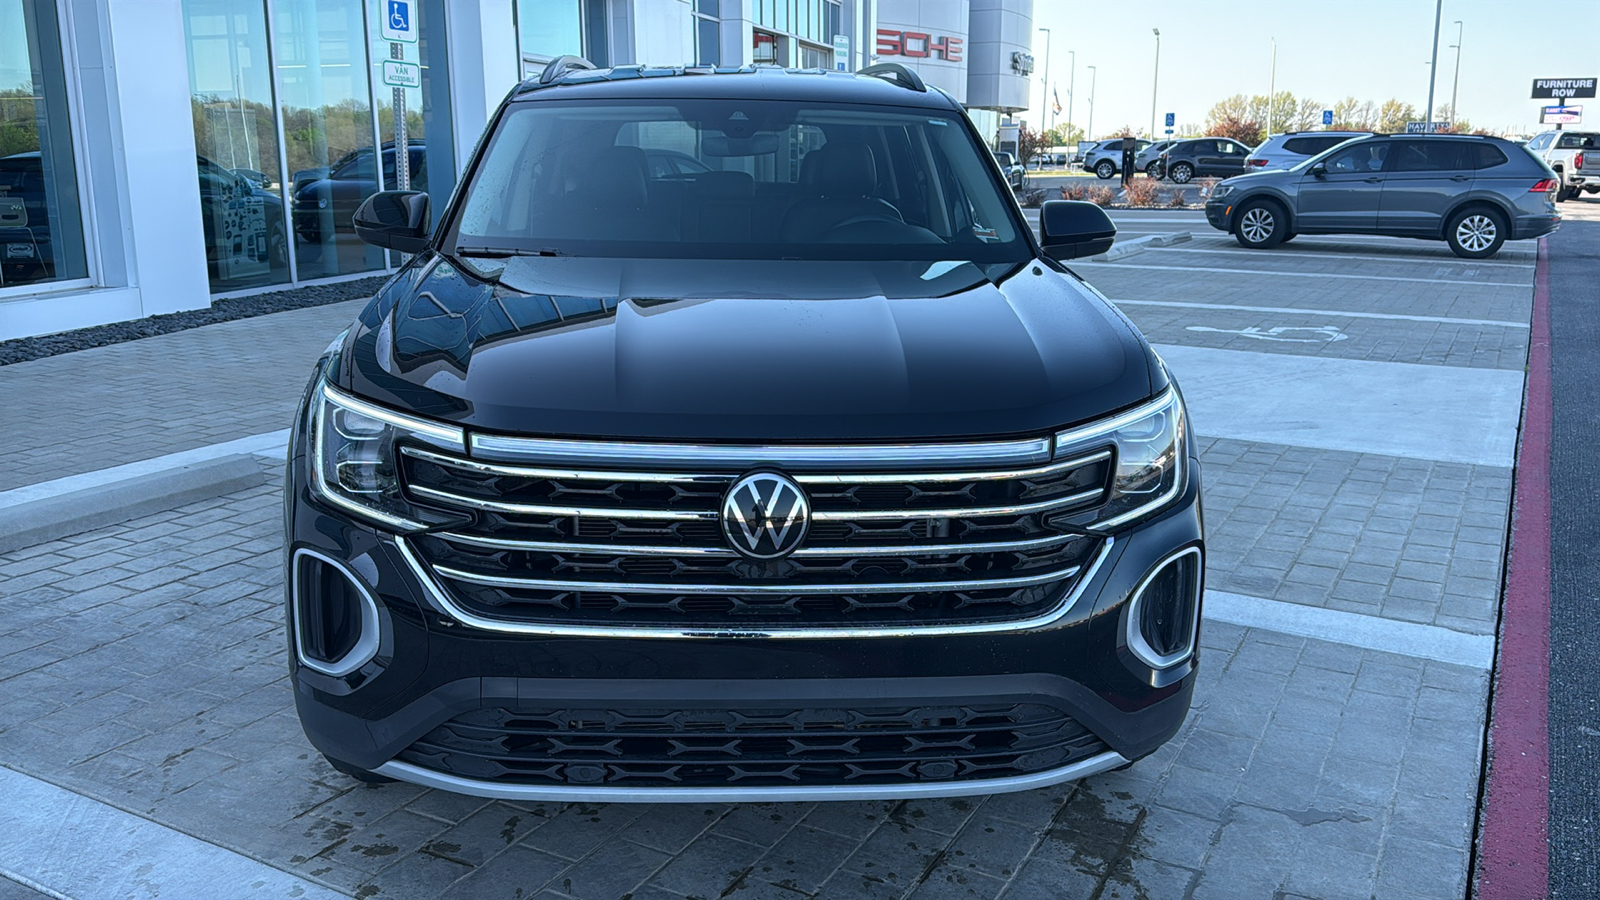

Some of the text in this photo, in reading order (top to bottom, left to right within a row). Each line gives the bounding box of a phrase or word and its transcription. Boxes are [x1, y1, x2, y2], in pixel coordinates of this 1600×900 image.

[394, 66, 409, 75] VAN
[388, 74, 415, 83] ACCESSIBLE
[1536, 79, 1593, 88] FURNITURE
[1551, 88, 1576, 97] ROW
